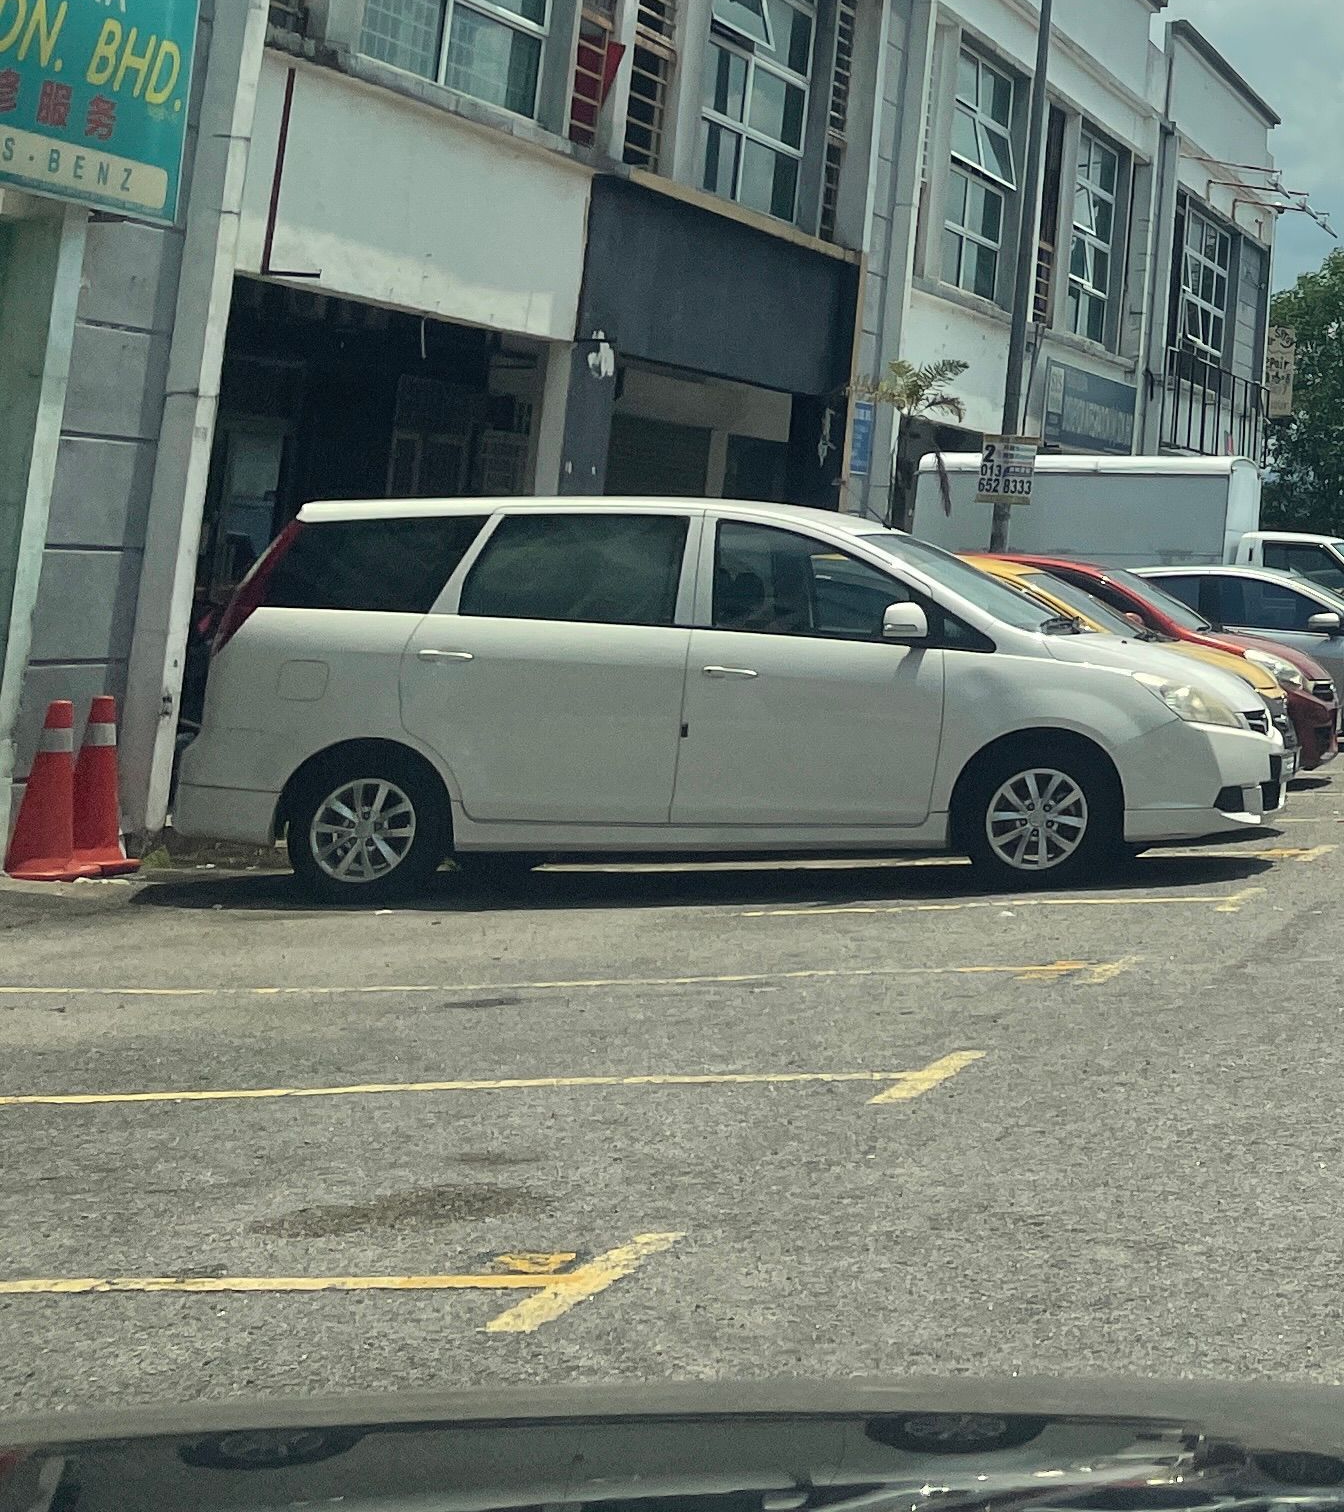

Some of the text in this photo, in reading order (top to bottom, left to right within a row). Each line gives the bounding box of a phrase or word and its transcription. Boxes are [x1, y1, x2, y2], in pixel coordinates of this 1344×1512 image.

[86, 17, 182, 112] BHD.
[983, 443, 996, 463] 2
[981, 463, 1002, 477] 013
[978, 477, 1032, 495] 652 8333
